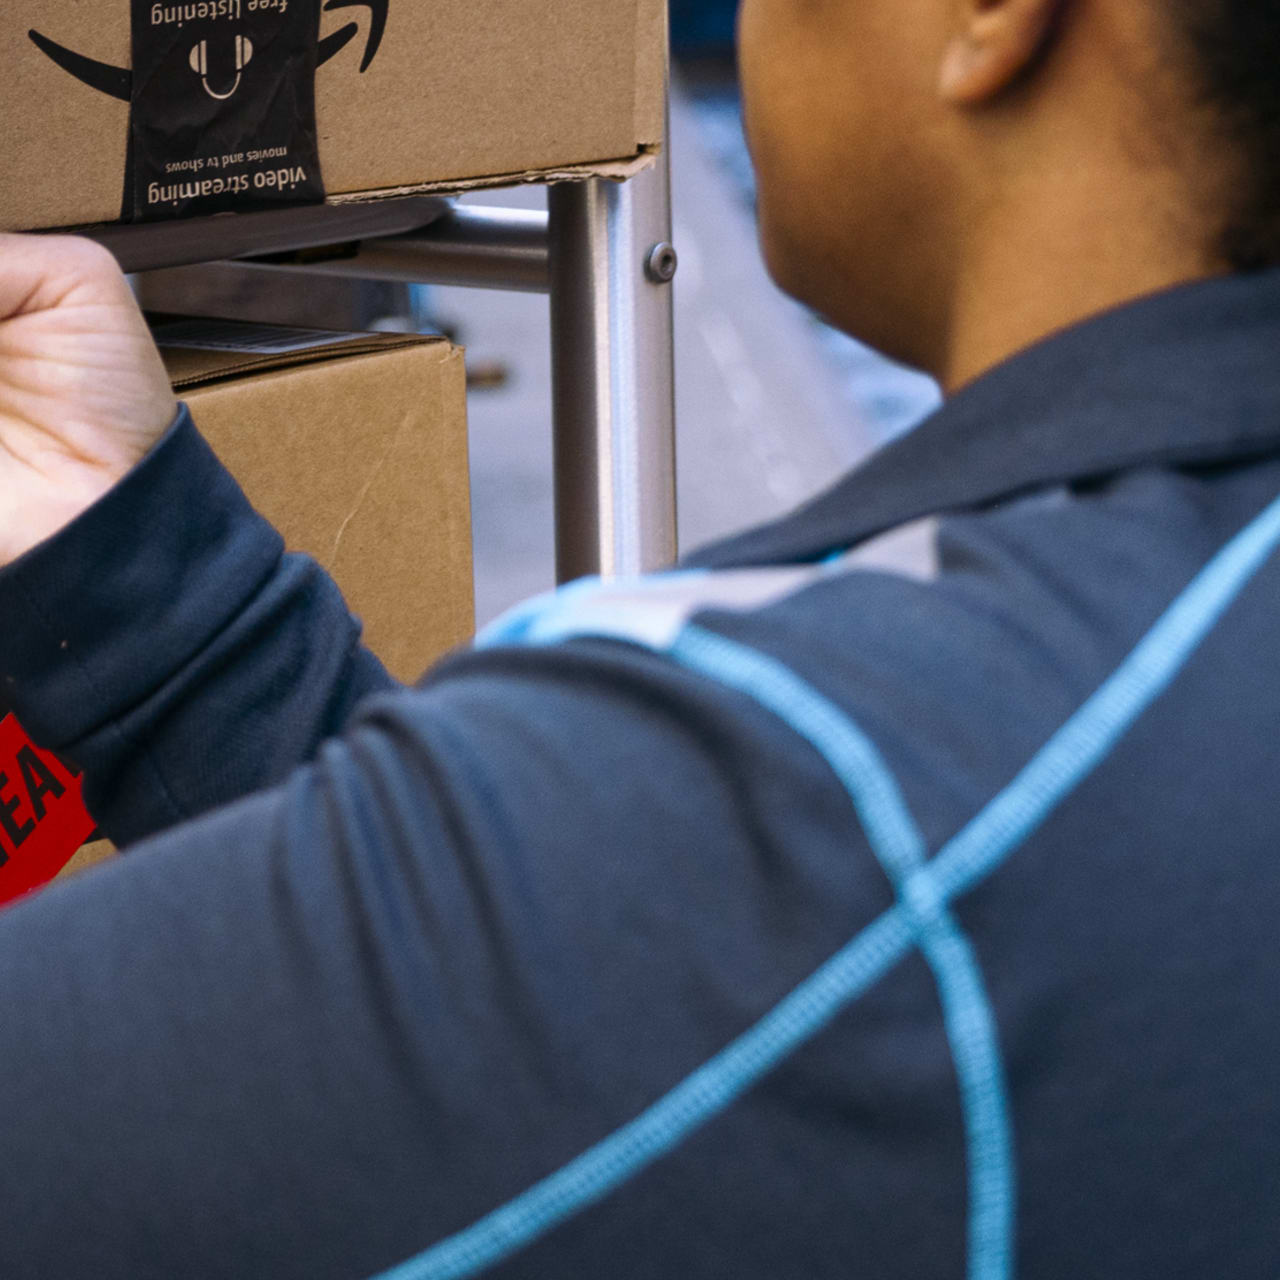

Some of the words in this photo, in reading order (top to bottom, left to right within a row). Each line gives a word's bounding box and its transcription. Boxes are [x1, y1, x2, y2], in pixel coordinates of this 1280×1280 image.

[221, 152, 245, 168] and
[245, 146, 287, 162] movies
[165, 158, 204, 174] shows
[206, 157, 220, 169] tv
[253, 165, 307, 191] video
[147, 175, 249, 207] streaming
